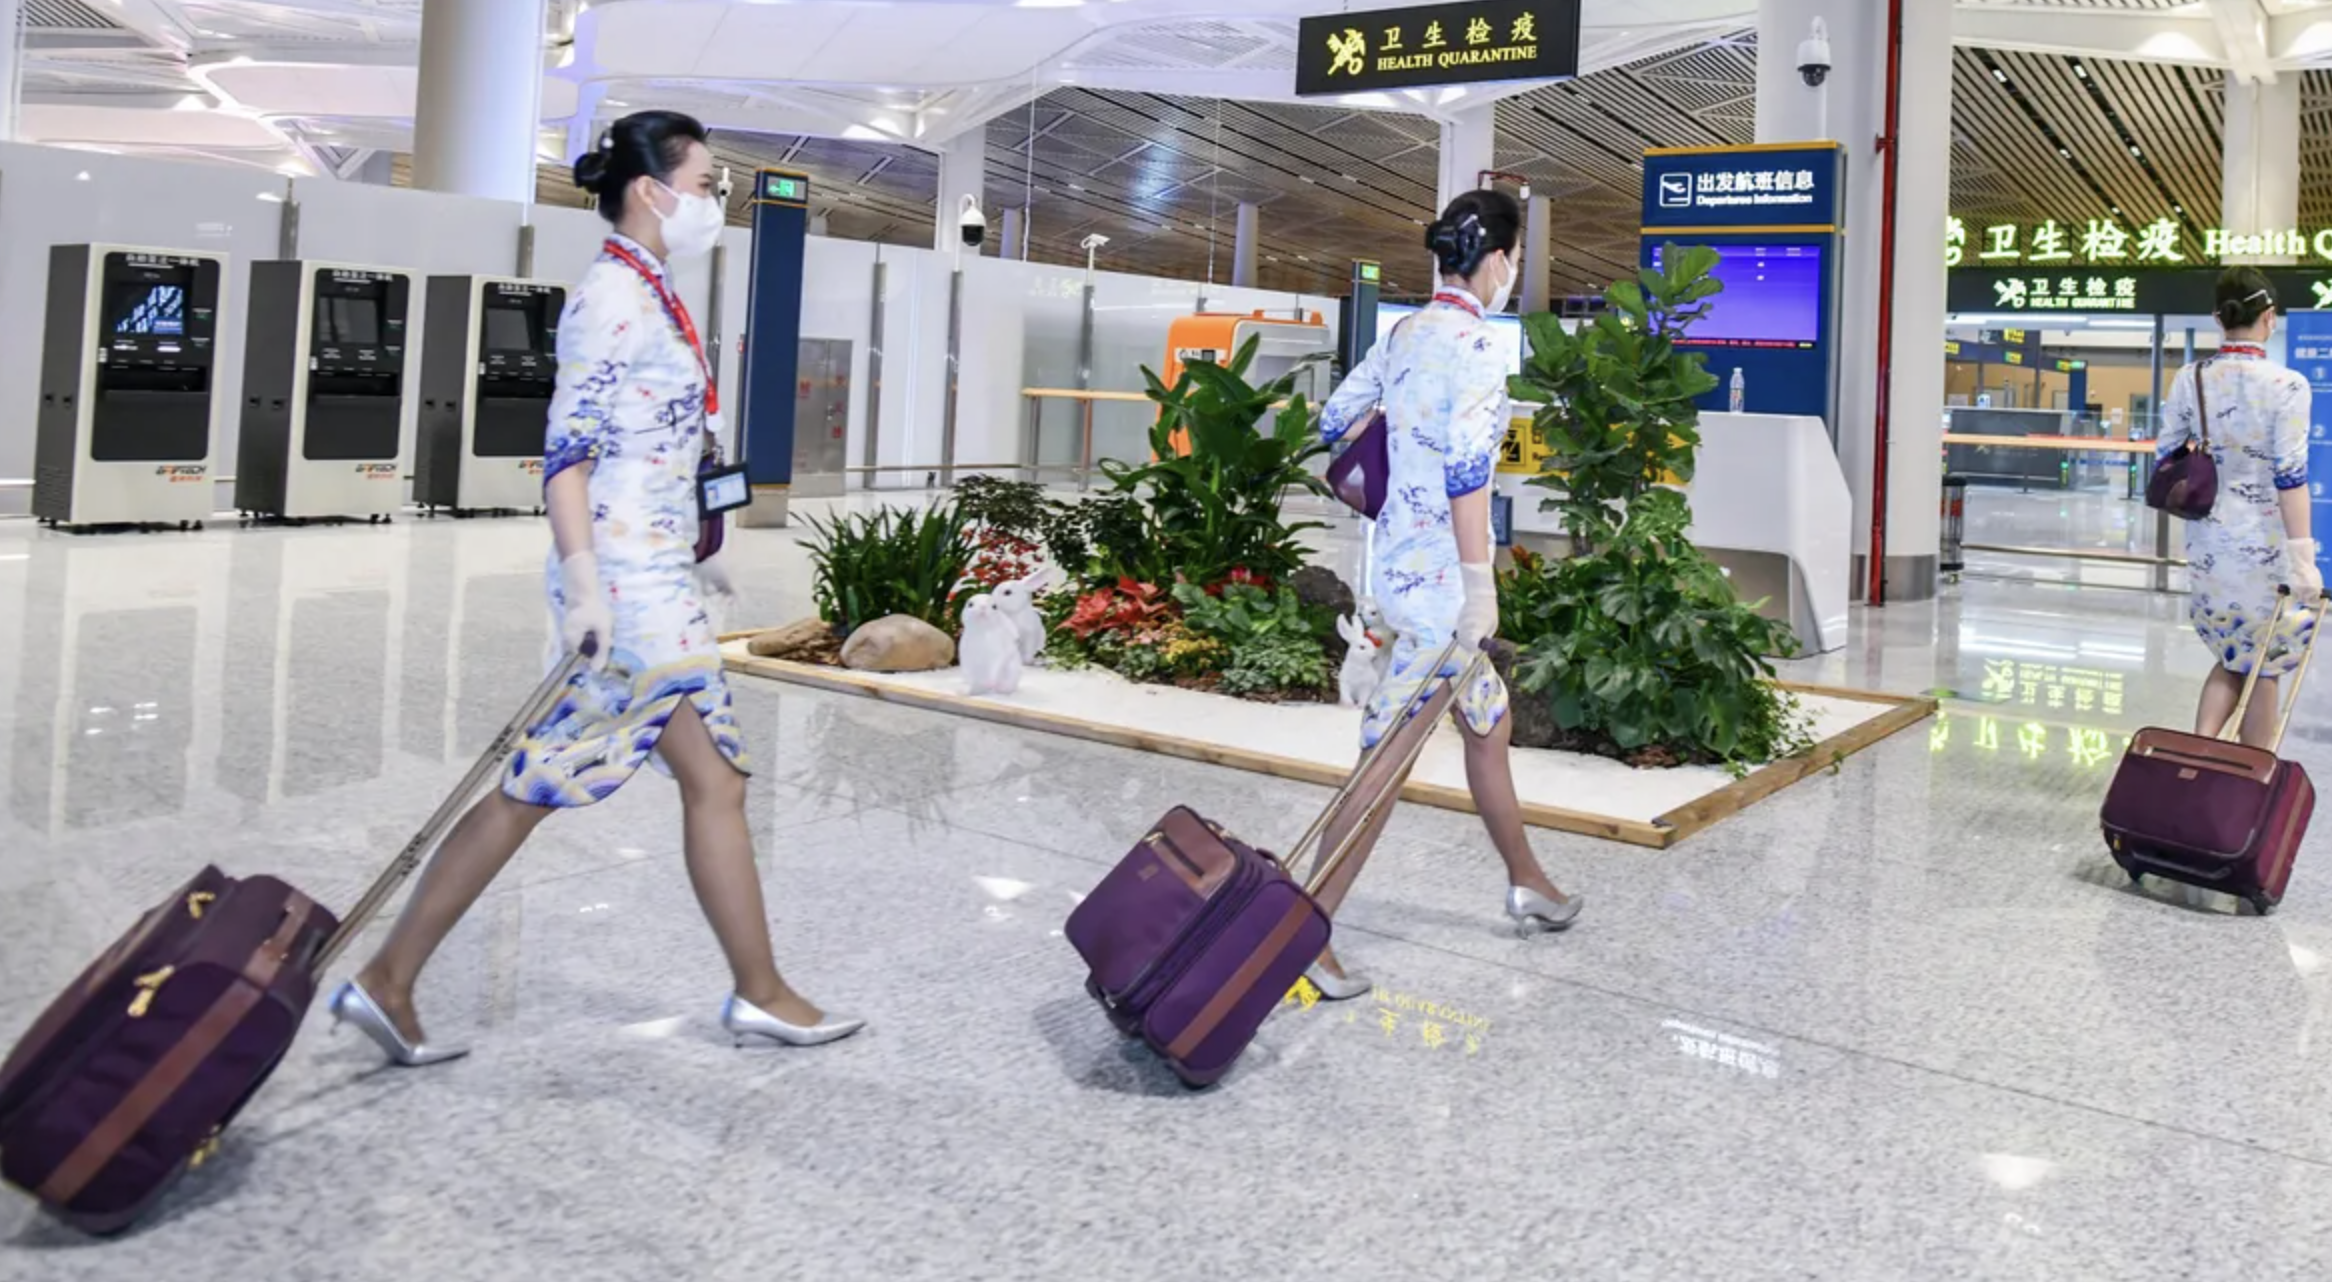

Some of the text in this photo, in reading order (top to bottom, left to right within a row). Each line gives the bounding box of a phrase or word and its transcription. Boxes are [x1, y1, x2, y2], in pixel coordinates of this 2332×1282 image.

[1379, 11, 1538, 51] 卫生检疫
[1377, 45, 1538, 71] HEALTH QUARANTINE
[1697, 170, 1815, 192] 出发航班信息
[1979, 217, 2186, 262] 卫生检疫
[2204, 228, 2307, 256] Health
[2030, 276, 2137, 297] 卫生检疫
[2030, 297, 2069, 309] HEALTH
